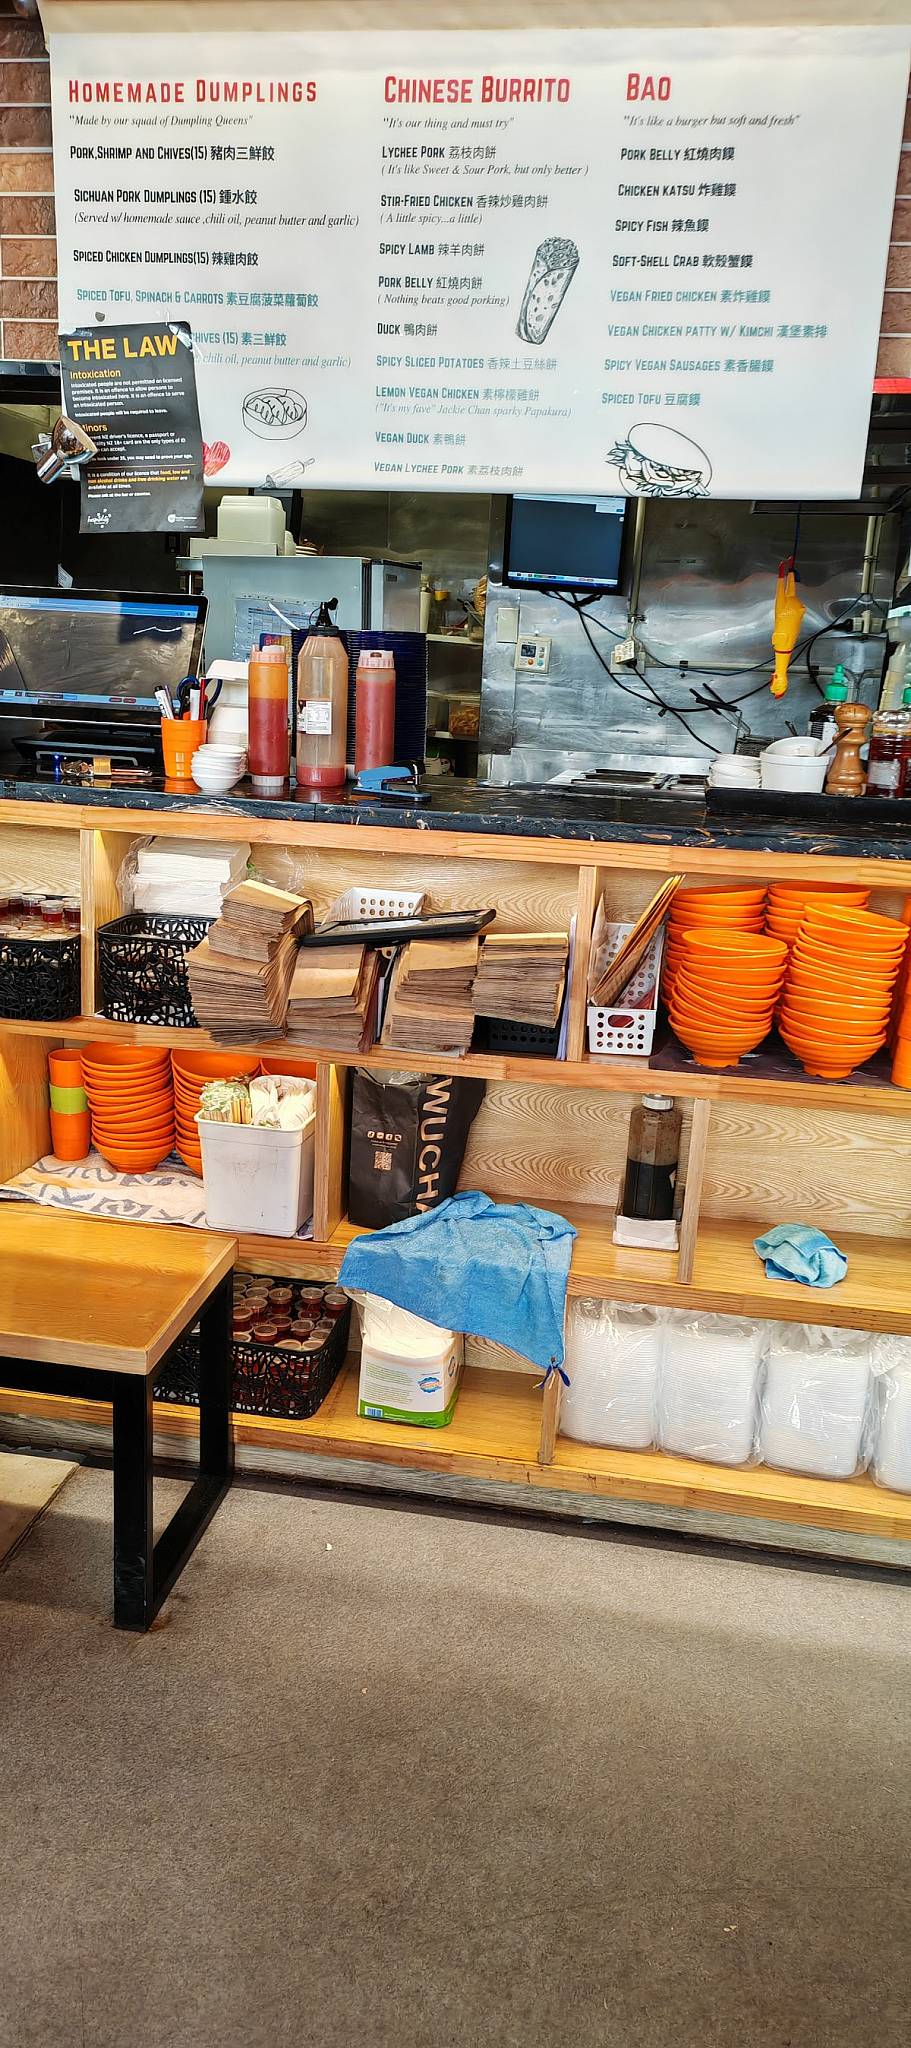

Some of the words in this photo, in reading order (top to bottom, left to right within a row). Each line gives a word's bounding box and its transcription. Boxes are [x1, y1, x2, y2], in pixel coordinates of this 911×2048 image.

[69, 80, 184, 103] HOMEMADE
[197, 80, 316, 102] DUMPLINGS
[385, 76, 473, 103] CHINESE
[482, 76, 570, 103] BURRITO
[627, 73, 671, 101] BAO
[70, 115, 98, 125] "Made
[101, 115, 111, 127] by
[131, 116, 157, 128] squad
[160, 116, 169, 128] of
[171, 115, 212, 127] Dumpling
[216, 115, 253, 127] Queens"
[425, 118, 448, 130] thing
[451, 118, 469, 128] and
[471, 120, 493, 128] must
[646, 115, 664, 126] like
[675, 116, 708, 128] burger
[710, 115, 726, 125] but
[728, 114, 747, 128] soft
[749, 115, 768, 125] and
[70, 146, 132, 160] PORK,SHRIMP
[135, 148, 154, 159] AND
[158, 146, 207, 160] CHIVES(15)
[211, 145, 274, 161] 豬肉三鮮餃
[382, 146, 418, 158] LYCHEE
[421, 146, 445, 158] PORK
[621, 148, 646, 160] PORK
[650, 148, 681, 160] BELLY
[404, 164, 420, 174] like
[423, 164, 449, 174] Sweet
[452, 165, 460, 174] &
[463, 165, 485, 174] Sour
[487, 164, 510, 174] Pork,
[514, 164, 529, 174] but
[532, 164, 552, 176] only
[618, 184, 659, 196] CHICKEN
[663, 185, 695, 196] KATSU
[74, 189, 113, 202] SICHUAN
[117, 189, 141, 202] PORK
[144, 190, 196, 203] DUMPLINGS
[200, 190, 216, 204] (15)
[381, 195, 430, 206] STIR-FRIED
[434, 195, 473, 207] CHICKEN
[75, 212, 109, 223] (Served
[124, 212, 173, 223] homemade
[228, 214, 241, 225] oil,
[244, 217, 276, 227] peanut
[279, 214, 306, 225] butter
[308, 215, 326, 225] and
[328, 214, 359, 228] garlic)
[396, 213, 416, 222] little
[458, 213, 482, 224] little)
[615, 220, 644, 231] SPICY
[646, 220, 668, 231] FISH
[380, 243, 406, 255] SPICY
[409, 243, 434, 255] LAMB
[74, 250, 103, 262] SPICED
[106, 250, 142, 262] CHICKEN
[145, 251, 209, 265] DUMPLINGS(15)
[613, 255, 669, 267] SOFT-SHELL
[673, 255, 699, 266] CRAB
[379, 276, 401, 288] PORK
[405, 276, 433, 288] BELLY
[77, 289, 107, 301] SPICED
[109, 290, 132, 303] TOFU,
[136, 290, 172, 303] SPINACH
[175, 291, 181, 303] &
[184, 292, 223, 304] CARROTS
[384, 294, 418, 305] Nothing
[422, 295, 445, 304] beats
[447, 295, 469, 306] good
[471, 295, 509, 307] porking)
[611, 290, 642, 302] VEGAN
[645, 290, 672, 301] FRIED
[676, 291, 717, 302] CHICKEN
[378, 323, 400, 334] DUCK
[608, 325, 639, 336] VEGAN
[642, 325, 683, 336] CHICKEN
[685, 326, 717, 336] PATTY
[721, 325, 736, 337] W/
[739, 325, 773, 337] KIMCHI
[223, 332, 238, 345] (15)
[67, 338, 117, 361] THE
[123, 335, 178, 358] LAW
[225, 353, 239, 365] oil,
[241, 353, 274, 367] peanut
[274, 355, 300, 366] butter
[302, 355, 319, 367] and
[320, 356, 351, 368] garlic)
[377, 355, 402, 367] SPICY
[405, 356, 435, 367] SLICED
[439, 357, 484, 368] POTATOES
[605, 359, 632, 370] SPICY
[636, 359, 667, 370] VEGAN
[669, 359, 721, 371] SAUSAGES
[70, 369, 121, 379] Intoxication
[376, 386, 405, 397] LEMON
[409, 387, 438, 398] VEGAN
[442, 387, 479, 399] CHICKEN
[602, 393, 634, 404] SPICED
[638, 393, 661, 404] TOFU
[398, 406, 411, 415] my
[437, 404, 465, 414] Jackie
[466, 404, 490, 414] Chan
[376, 432, 403, 443] VEGAN
[407, 433, 429, 443] DUCK
[375, 462, 403, 472] VEGAN
[405, 463, 438, 473] LYCHEE
[441, 464, 464, 474] PORK
